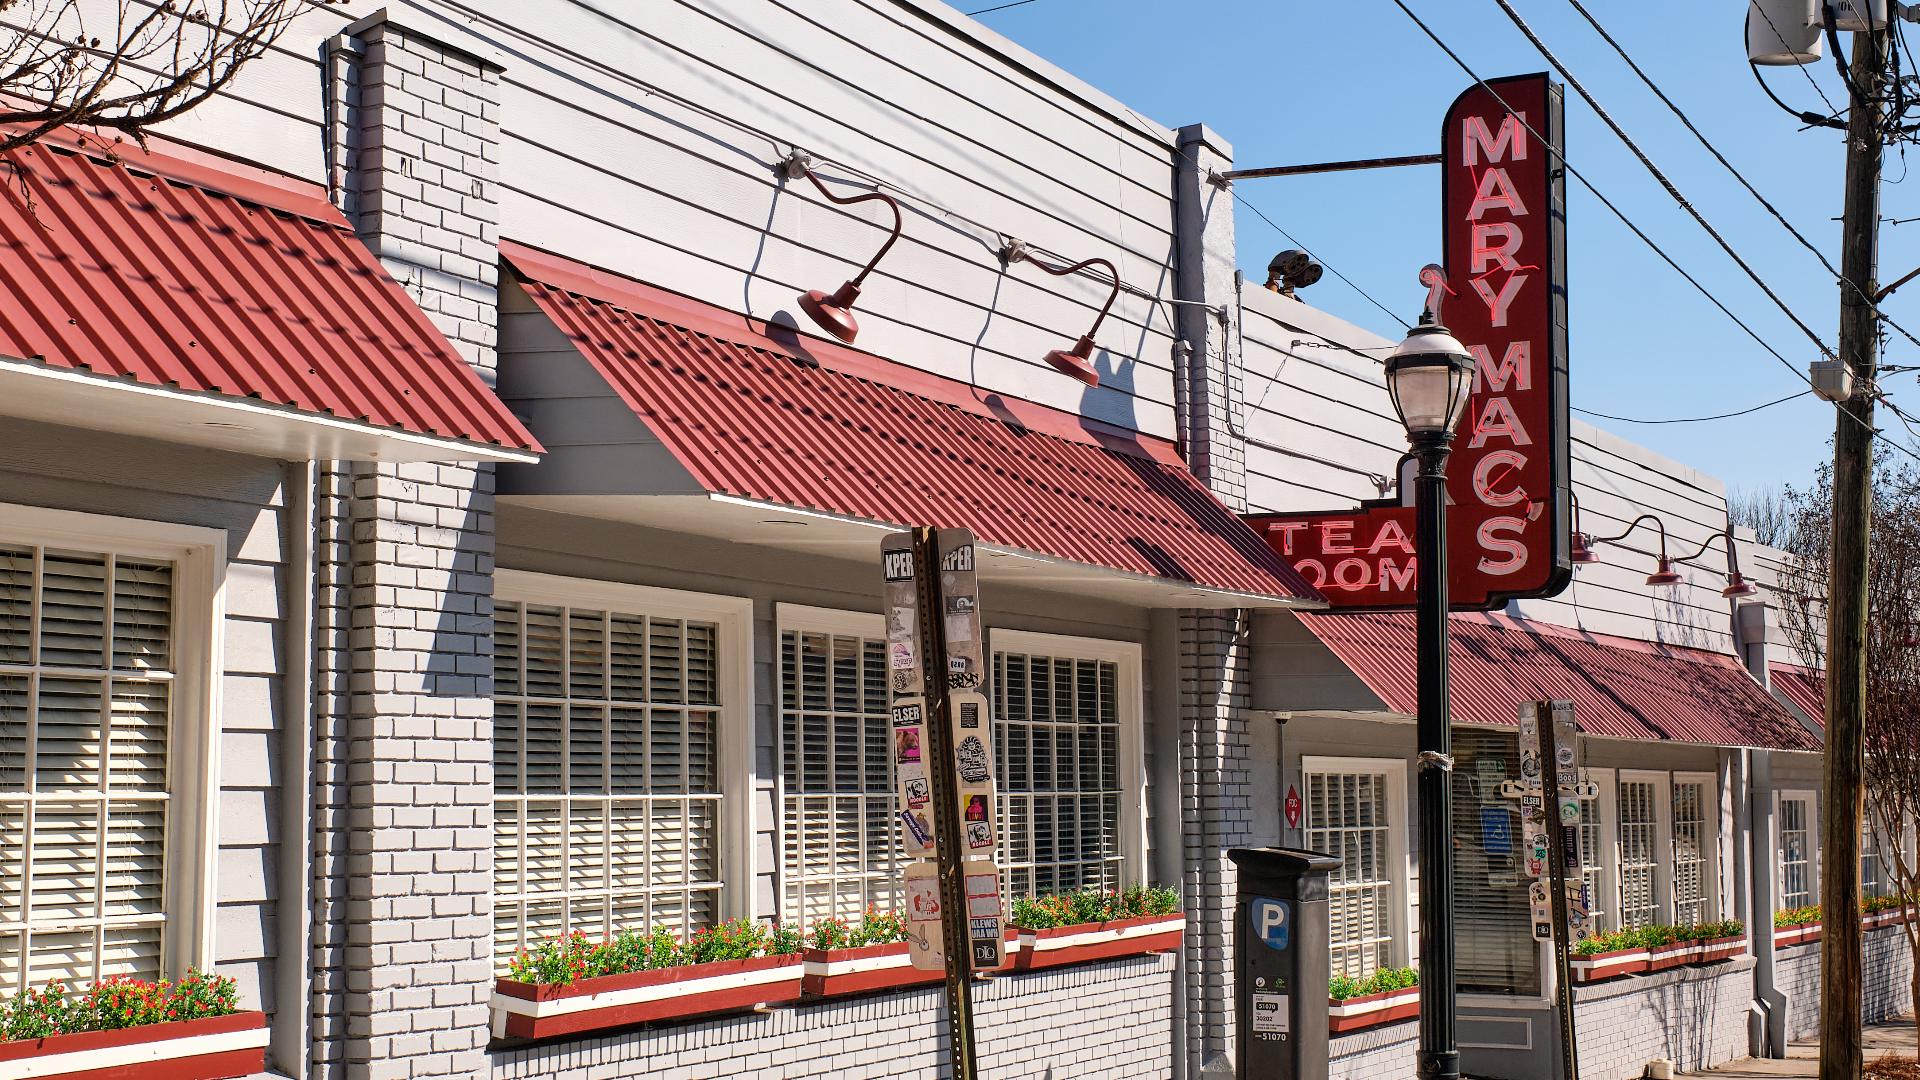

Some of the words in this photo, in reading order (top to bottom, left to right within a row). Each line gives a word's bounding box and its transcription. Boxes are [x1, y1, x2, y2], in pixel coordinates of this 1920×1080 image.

[1462, 111, 1530, 327] MARY
[1269, 519, 1416, 556] TEA
[1293, 557, 1416, 592] OOM
[892, 706, 920, 722] ELSER
[1523, 796, 1540, 806] ELSER
[970, 918, 998, 929] KLEWS
[1261, 903, 1285, 939] P
[1262, 1032, 1287, 1041] 51070
